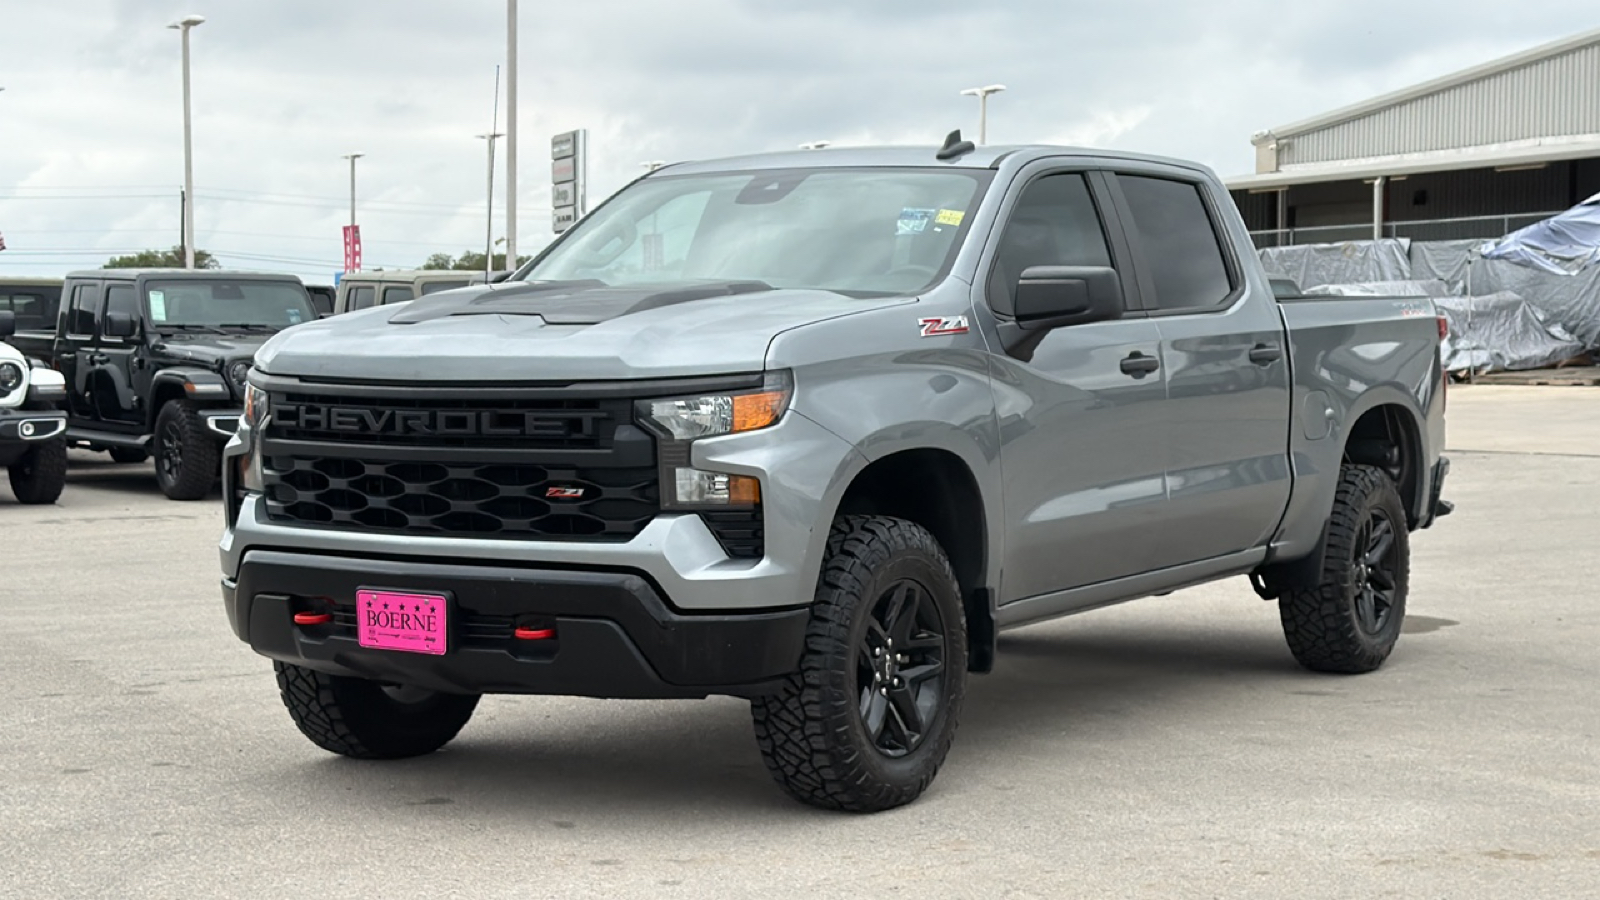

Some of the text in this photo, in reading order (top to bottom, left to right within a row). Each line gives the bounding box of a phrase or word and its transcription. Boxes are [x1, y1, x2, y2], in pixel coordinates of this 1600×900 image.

[917, 315, 970, 336] Z71
[272, 404, 608, 435] CHEVROLET
[545, 486, 585, 497] Z71
[366, 609, 437, 632] BOERNE
